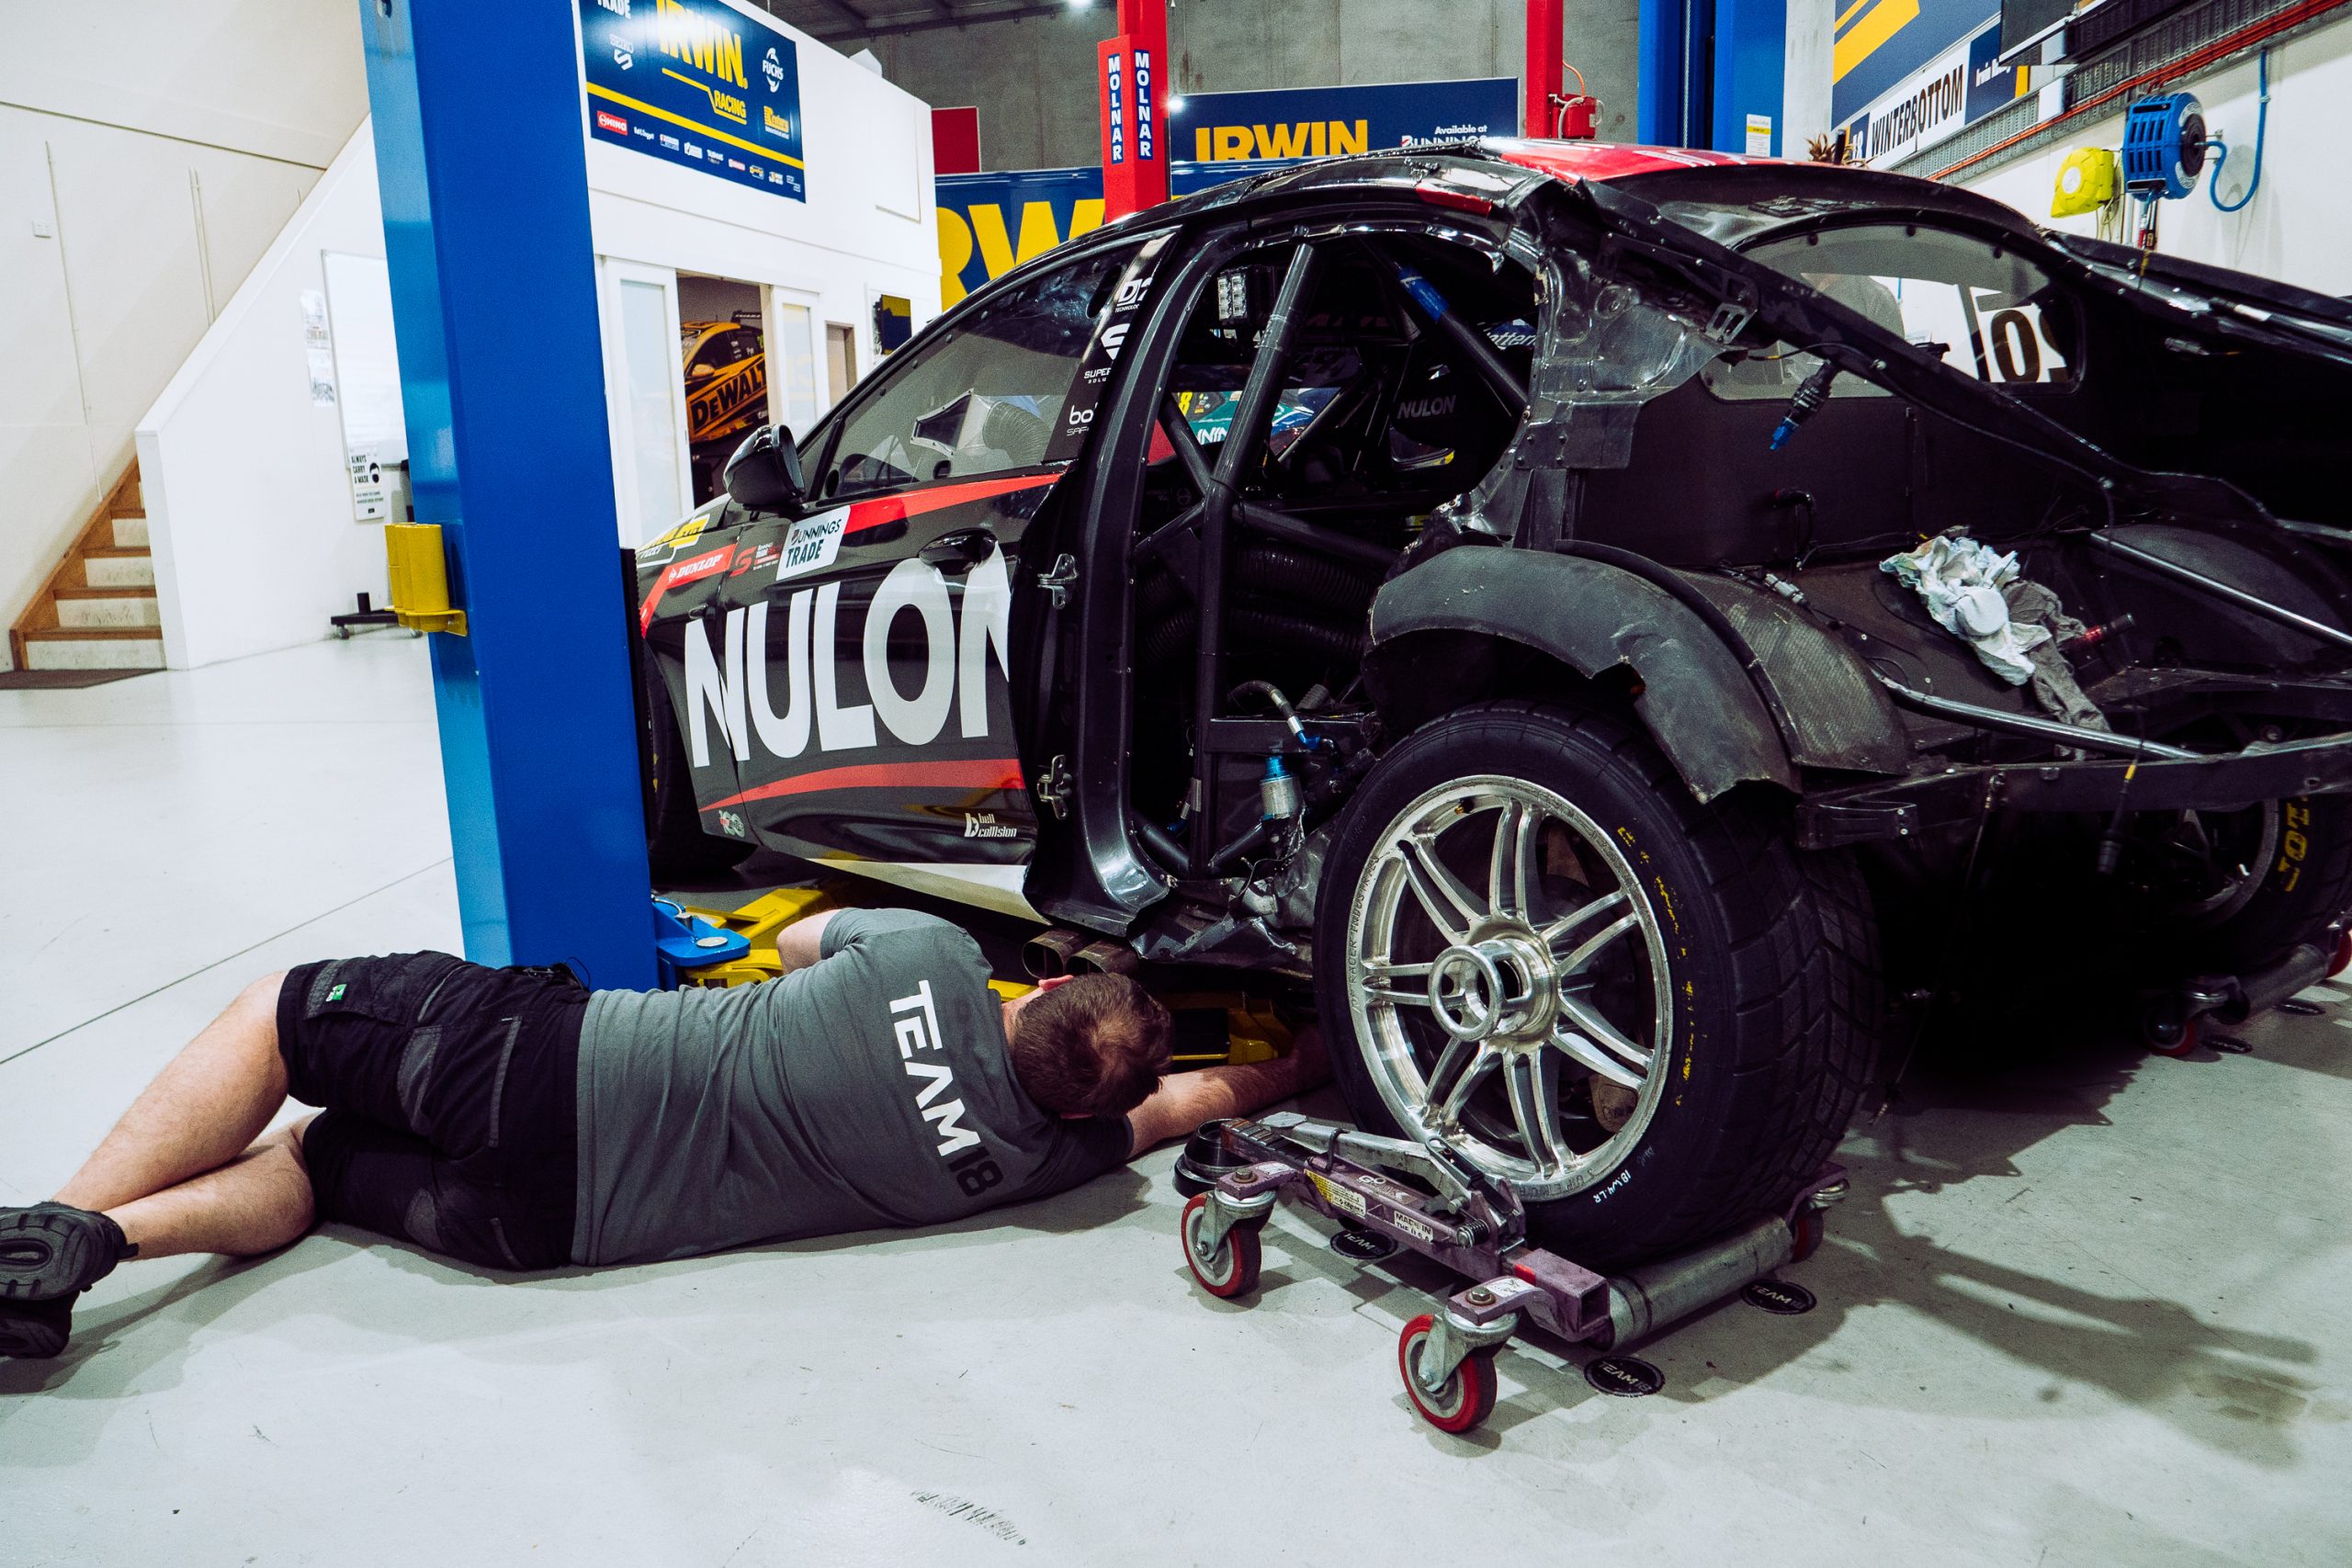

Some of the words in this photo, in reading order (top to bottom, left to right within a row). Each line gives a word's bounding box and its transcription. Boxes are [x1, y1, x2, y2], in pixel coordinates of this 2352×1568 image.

[762, 59, 784, 81] FUCHS
[714, 89, 747, 118] RACING
[1108, 55, 1123, 161] MOLNAR
[1135, 51, 1152, 157] MOLNAR
[1871, 63, 1964, 158] WINTERBOTTOM
[1195, 119, 1368, 161] IRWIN
[1434, 123, 1476, 135] Available
[1477, 124, 1487, 132] at
[1397, 394, 1456, 419] NULON
[353, 465, 366, 474] CARRY
[790, 518, 842, 546] BUNNINGS
[676, 553, 724, 581] DUNLOP
[786, 539, 824, 568] TRADE
[684, 540, 1011, 768] NULON
[978, 812, 996, 824] bell
[1396, 1212, 1418, 1227] MADE
[1421, 1225, 1431, 1235] IN
